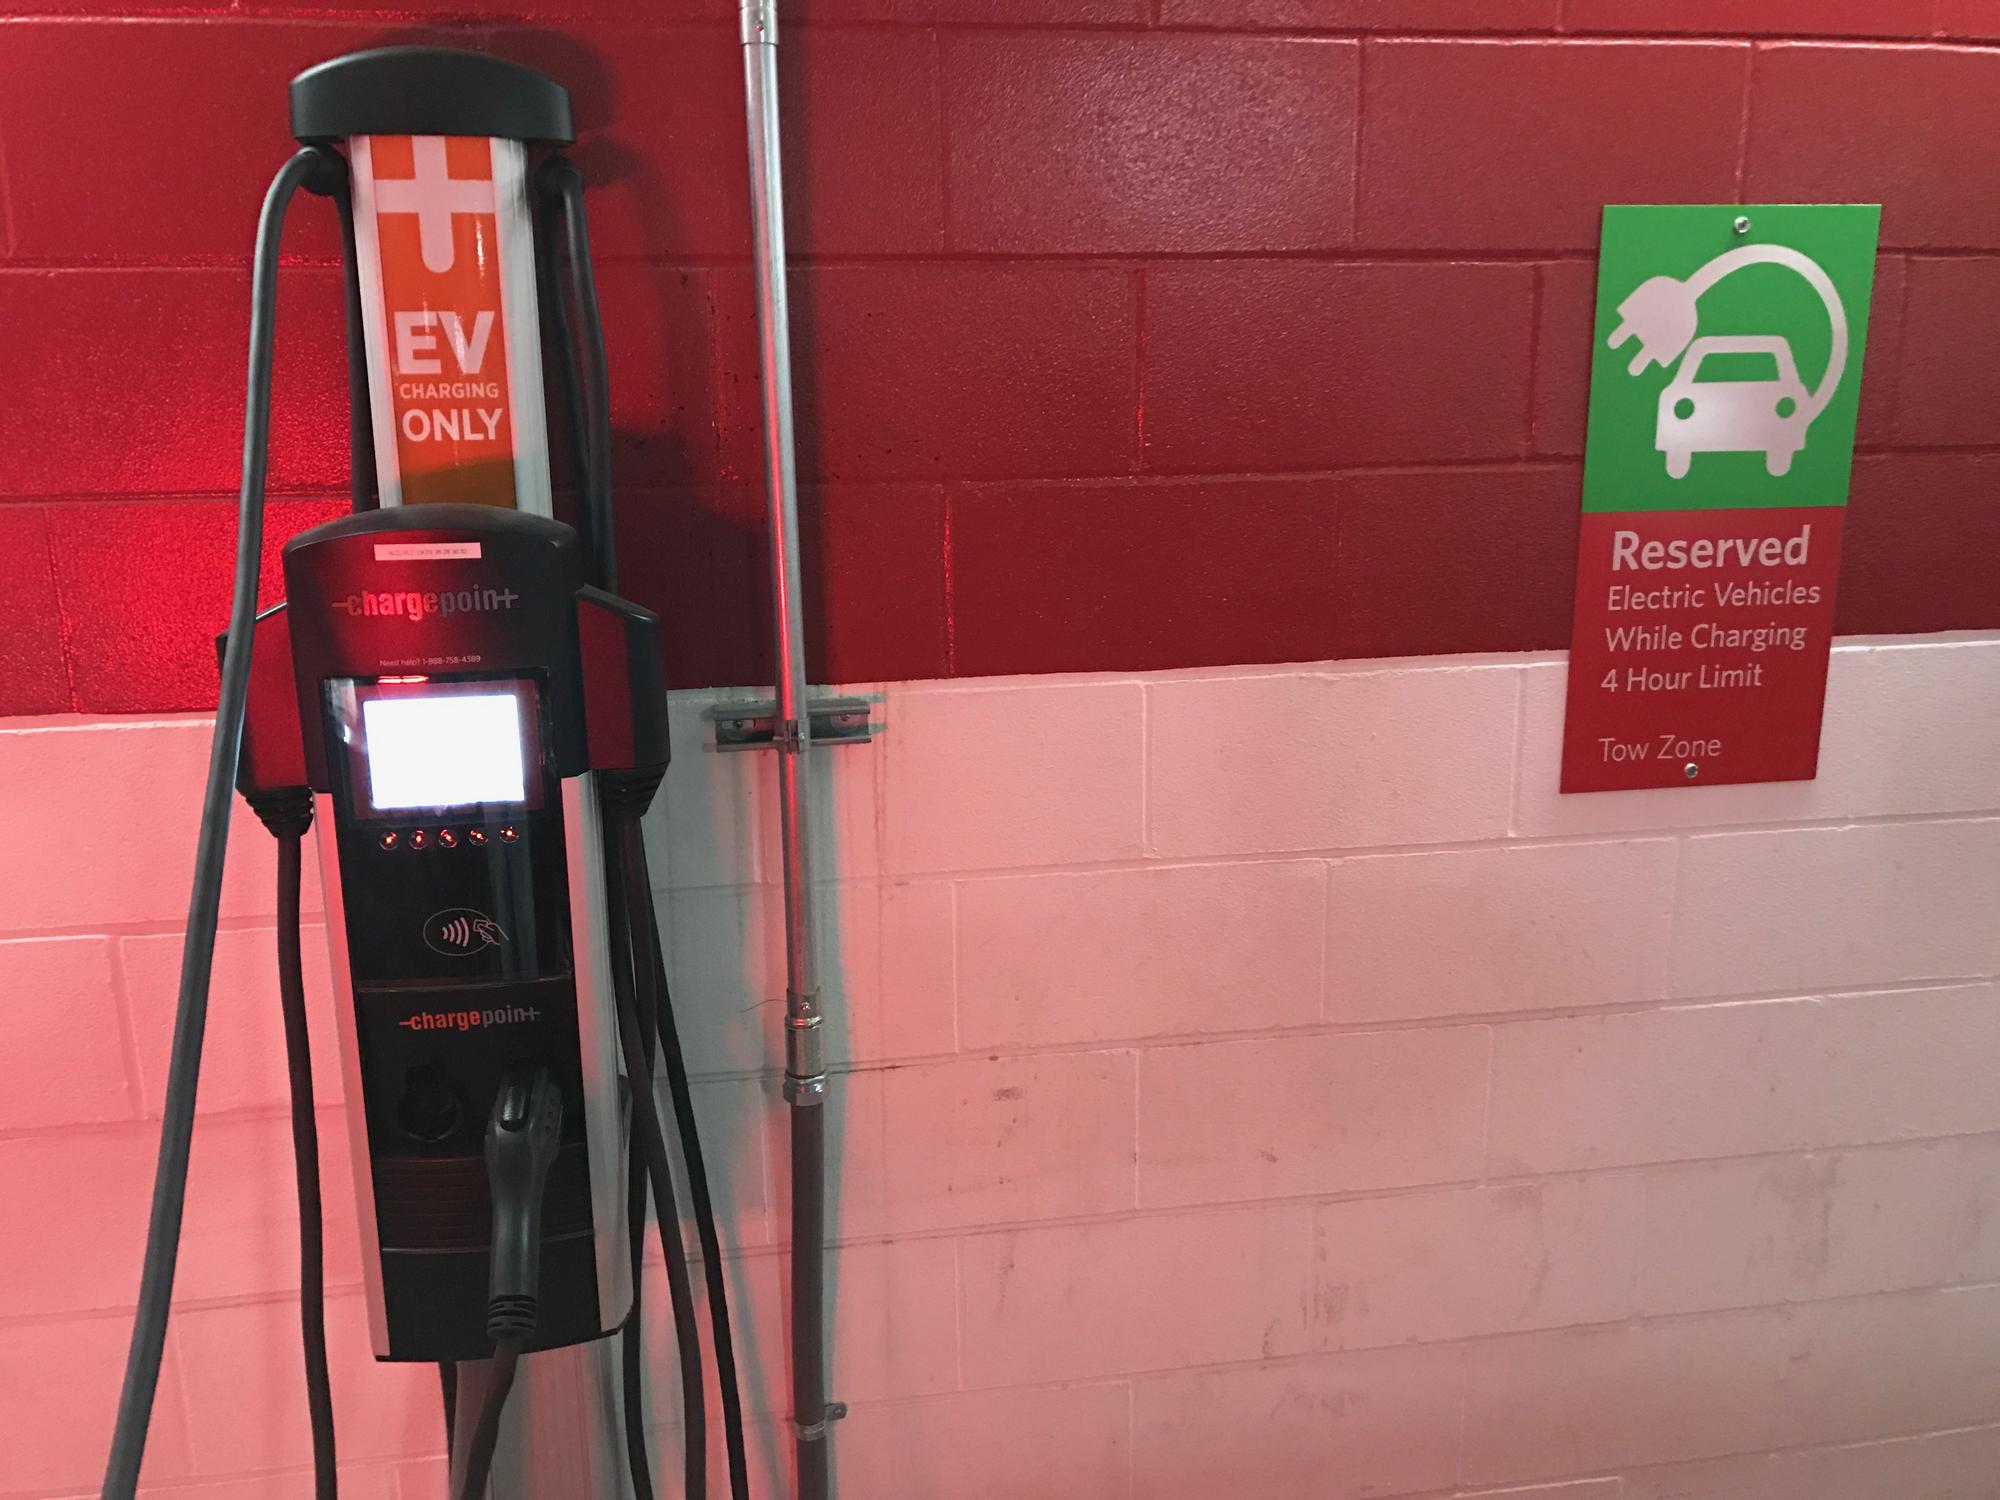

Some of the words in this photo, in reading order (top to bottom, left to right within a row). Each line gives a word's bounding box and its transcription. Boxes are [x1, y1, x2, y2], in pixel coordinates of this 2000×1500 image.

[394, 311, 495, 375] EV
[400, 383, 499, 399] CHARGING
[402, 408, 503, 441] ONLY
[1612, 524, 1811, 571] Reserved
[1608, 584, 1705, 611] Electric
[1714, 580, 1820, 607] Vehicles
[1605, 625, 1682, 652] While
[1691, 622, 1807, 651] Charging
[380, 659, 399, 667] Need
[401, 657, 420, 668] help?
[1601, 669, 1618, 692] 4
[1627, 667, 1692, 691] Hour
[1700, 663, 1762, 688] Limit
[1599, 738, 1649, 762] Tow
[1657, 735, 1721, 759] Zone
